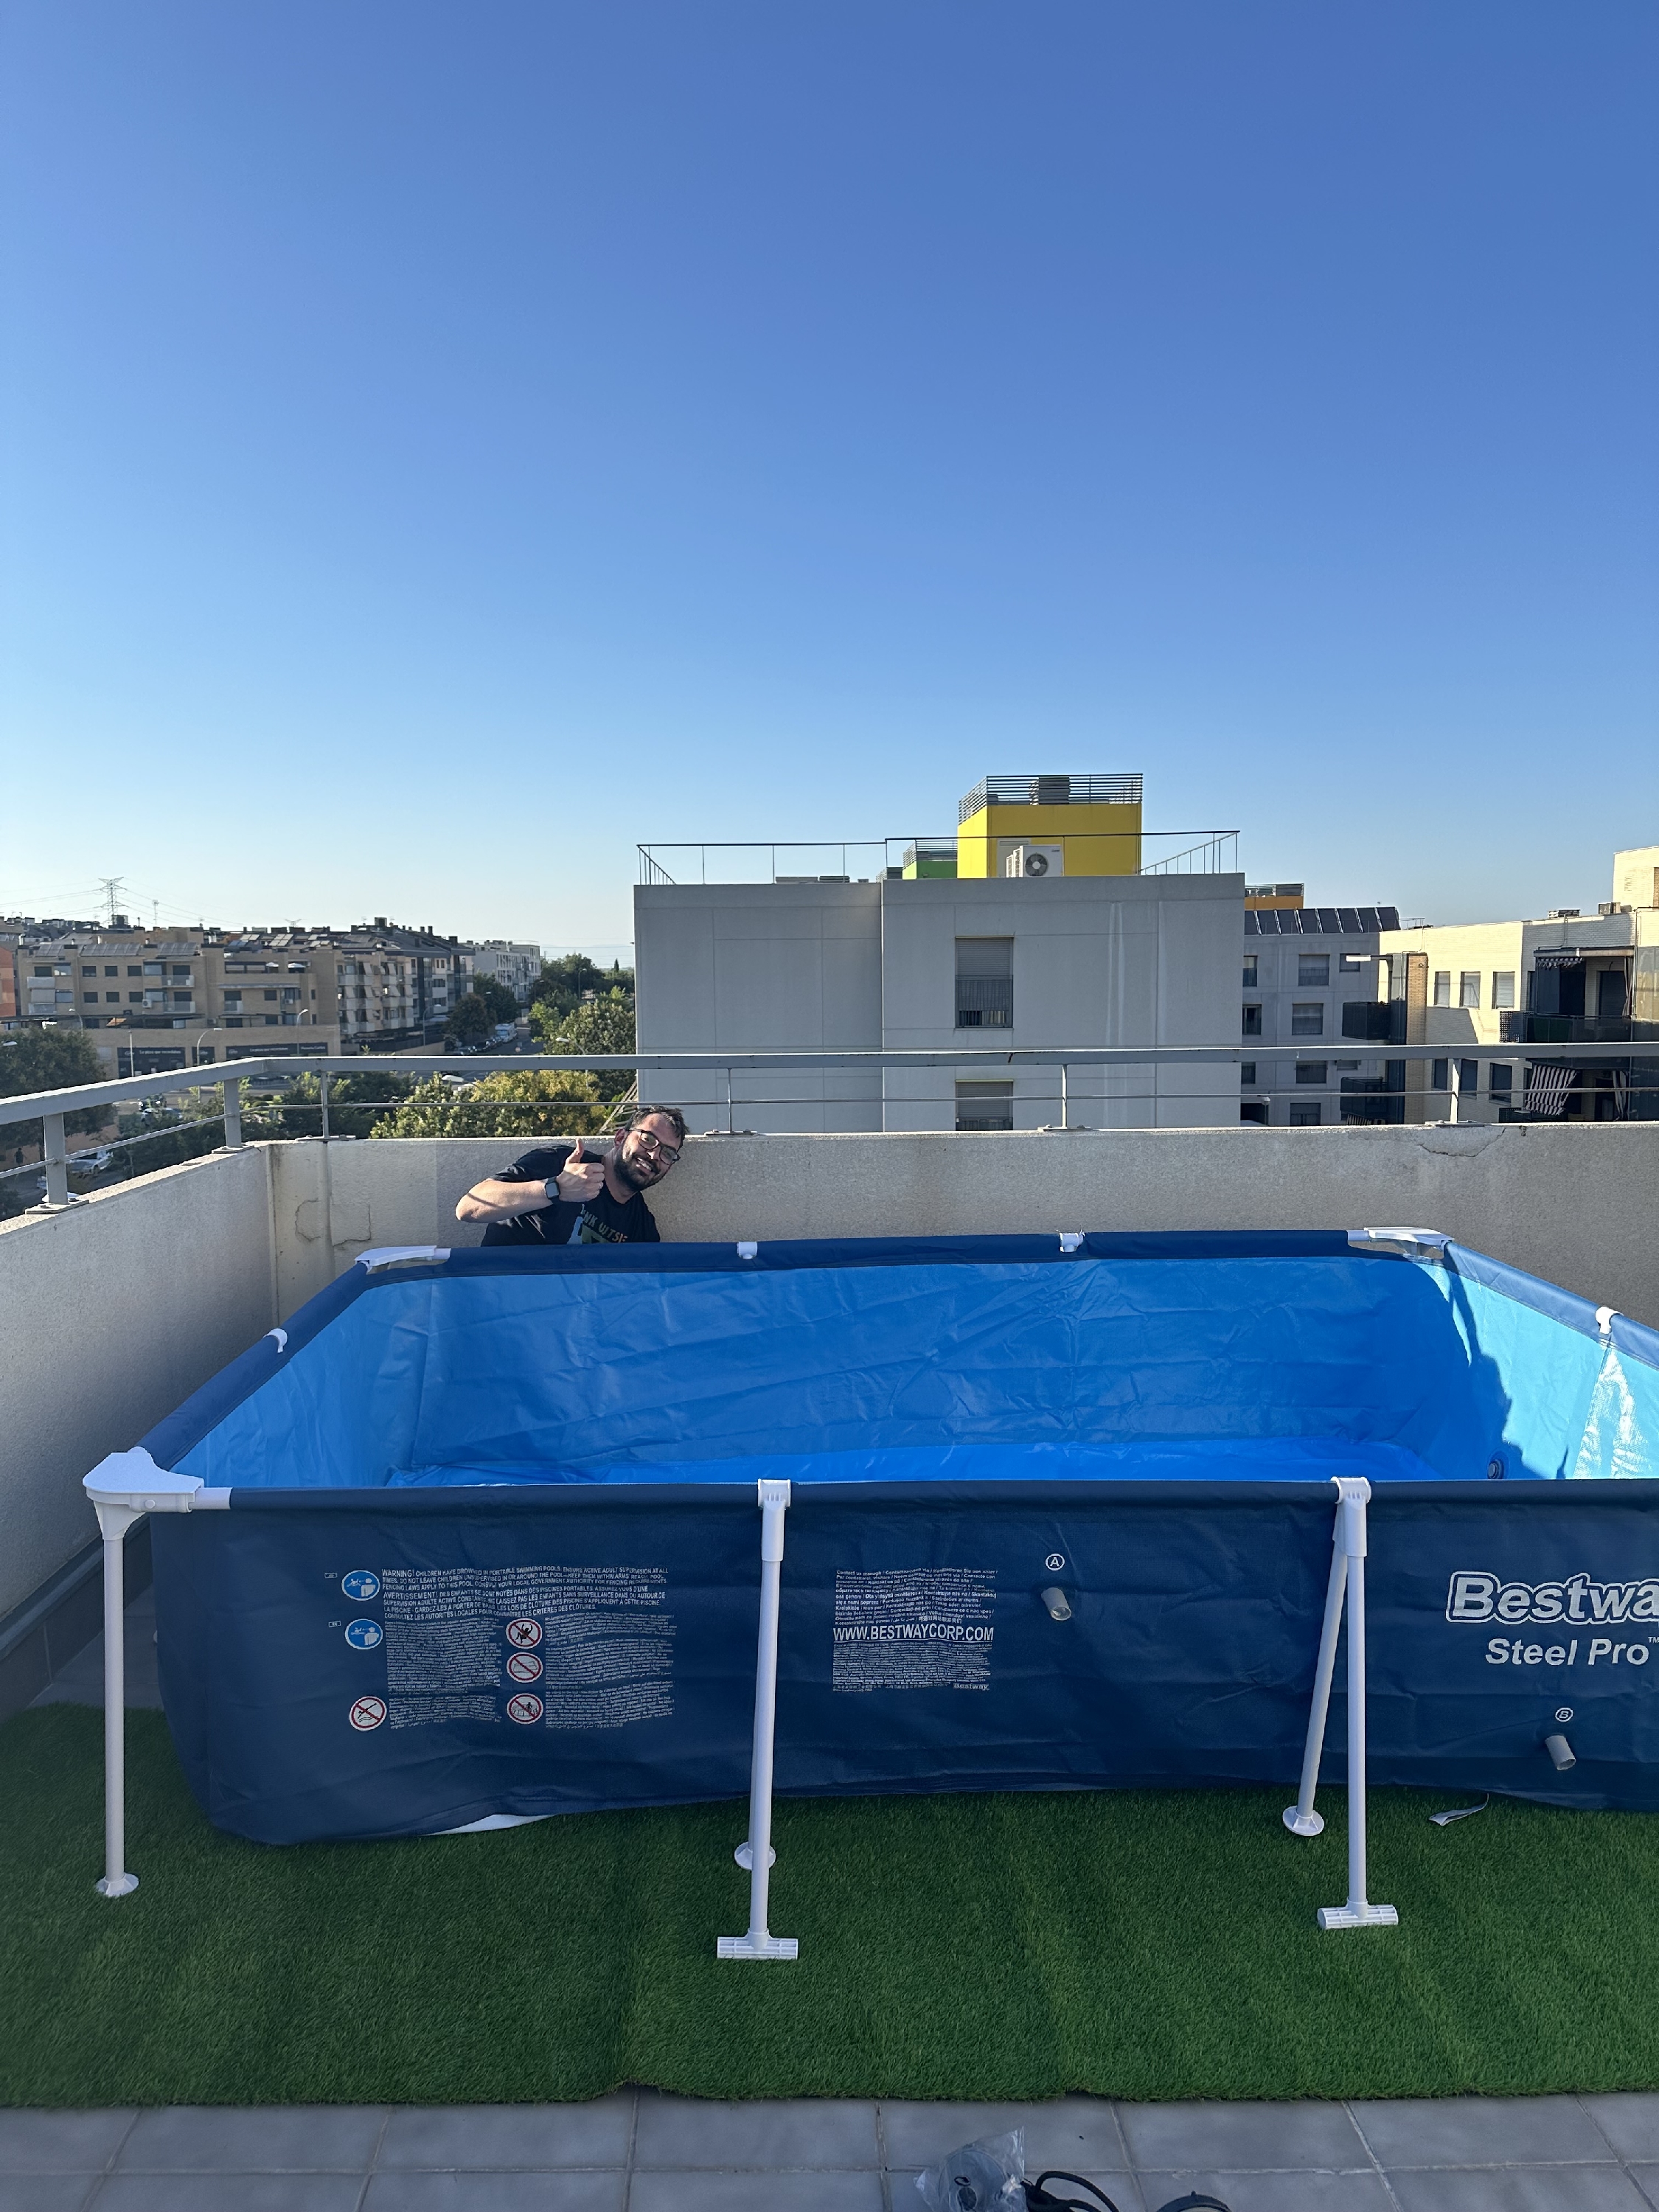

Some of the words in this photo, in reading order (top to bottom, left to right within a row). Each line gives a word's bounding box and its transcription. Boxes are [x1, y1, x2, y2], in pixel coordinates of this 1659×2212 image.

[382, 1569, 414, 1577] WARNING!
[383, 1592, 438, 1600] AVERTISSEMENT!
[1446, 1571, 1659, 1625] Bestwa
[833, 1624, 994, 1641] WWW.BESTWAYCORP.COM
[1485, 1638, 1578, 1665] Steel
